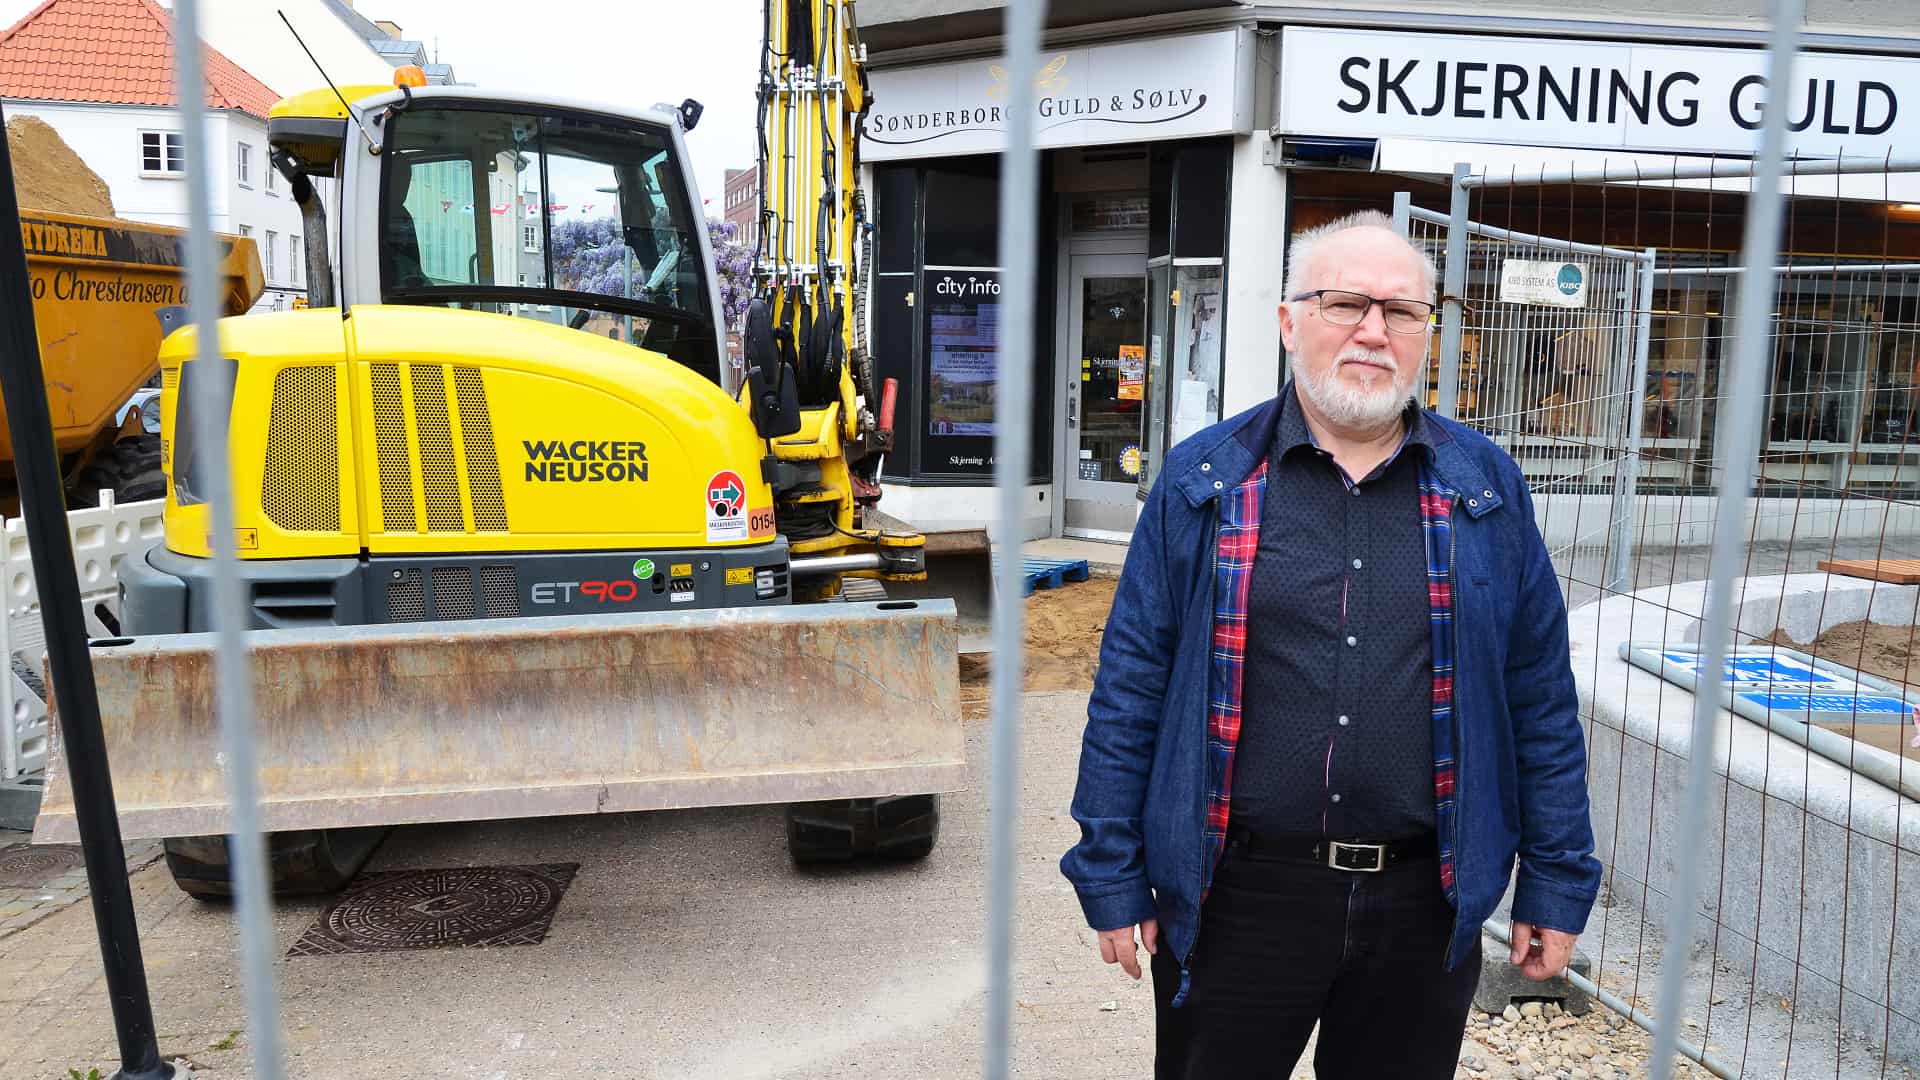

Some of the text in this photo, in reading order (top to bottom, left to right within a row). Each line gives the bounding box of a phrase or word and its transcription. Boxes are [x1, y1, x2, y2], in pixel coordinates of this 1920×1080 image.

[1039, 97, 1100, 117] GULD
[1110, 95, 1124, 111] &
[1132, 88, 1193, 111] SØLV
[1337, 56, 1898, 135] SKJERNING GULD
[54, 270, 174, 304] Chrestensen
[936, 277, 1000, 297] city info
[523, 441, 648, 461] WACKER
[949, 456, 983, 466] Skjerning
[525, 462, 649, 482] NEUSON
[751, 511, 775, 531] 0154
[531, 580, 637, 604] ET90
